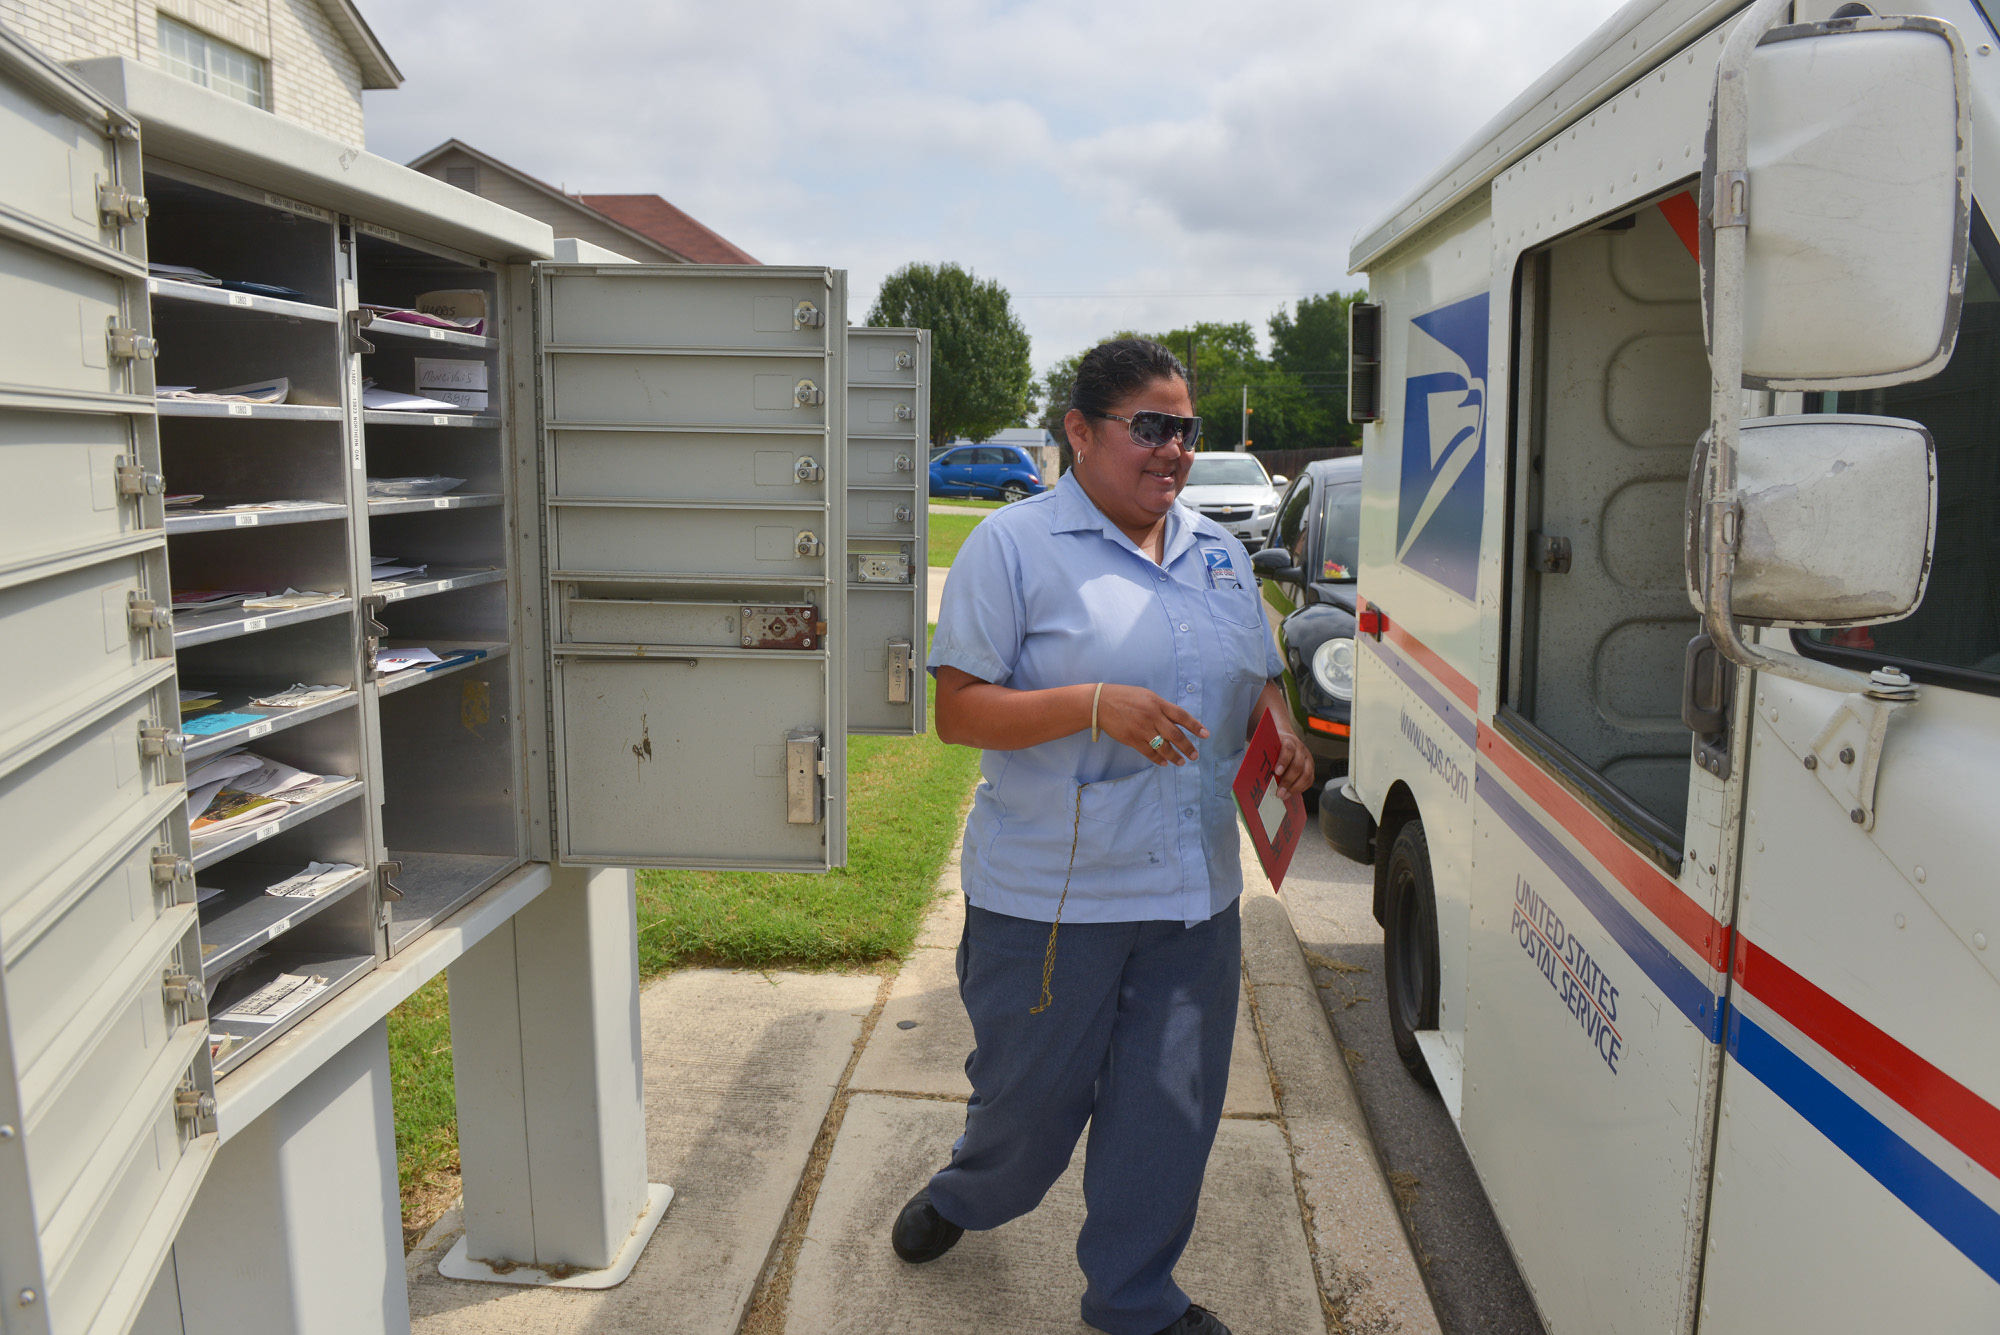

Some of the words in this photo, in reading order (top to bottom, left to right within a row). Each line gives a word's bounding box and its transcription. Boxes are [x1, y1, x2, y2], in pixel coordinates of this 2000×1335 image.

[1401, 709, 1468, 804] www.usps.com
[1511, 907, 1557, 990] POSTAL
[1559, 970, 1622, 1076] SERVICE
[1516, 872, 1565, 950] UNITED
[1565, 933, 1619, 1022] STATES
